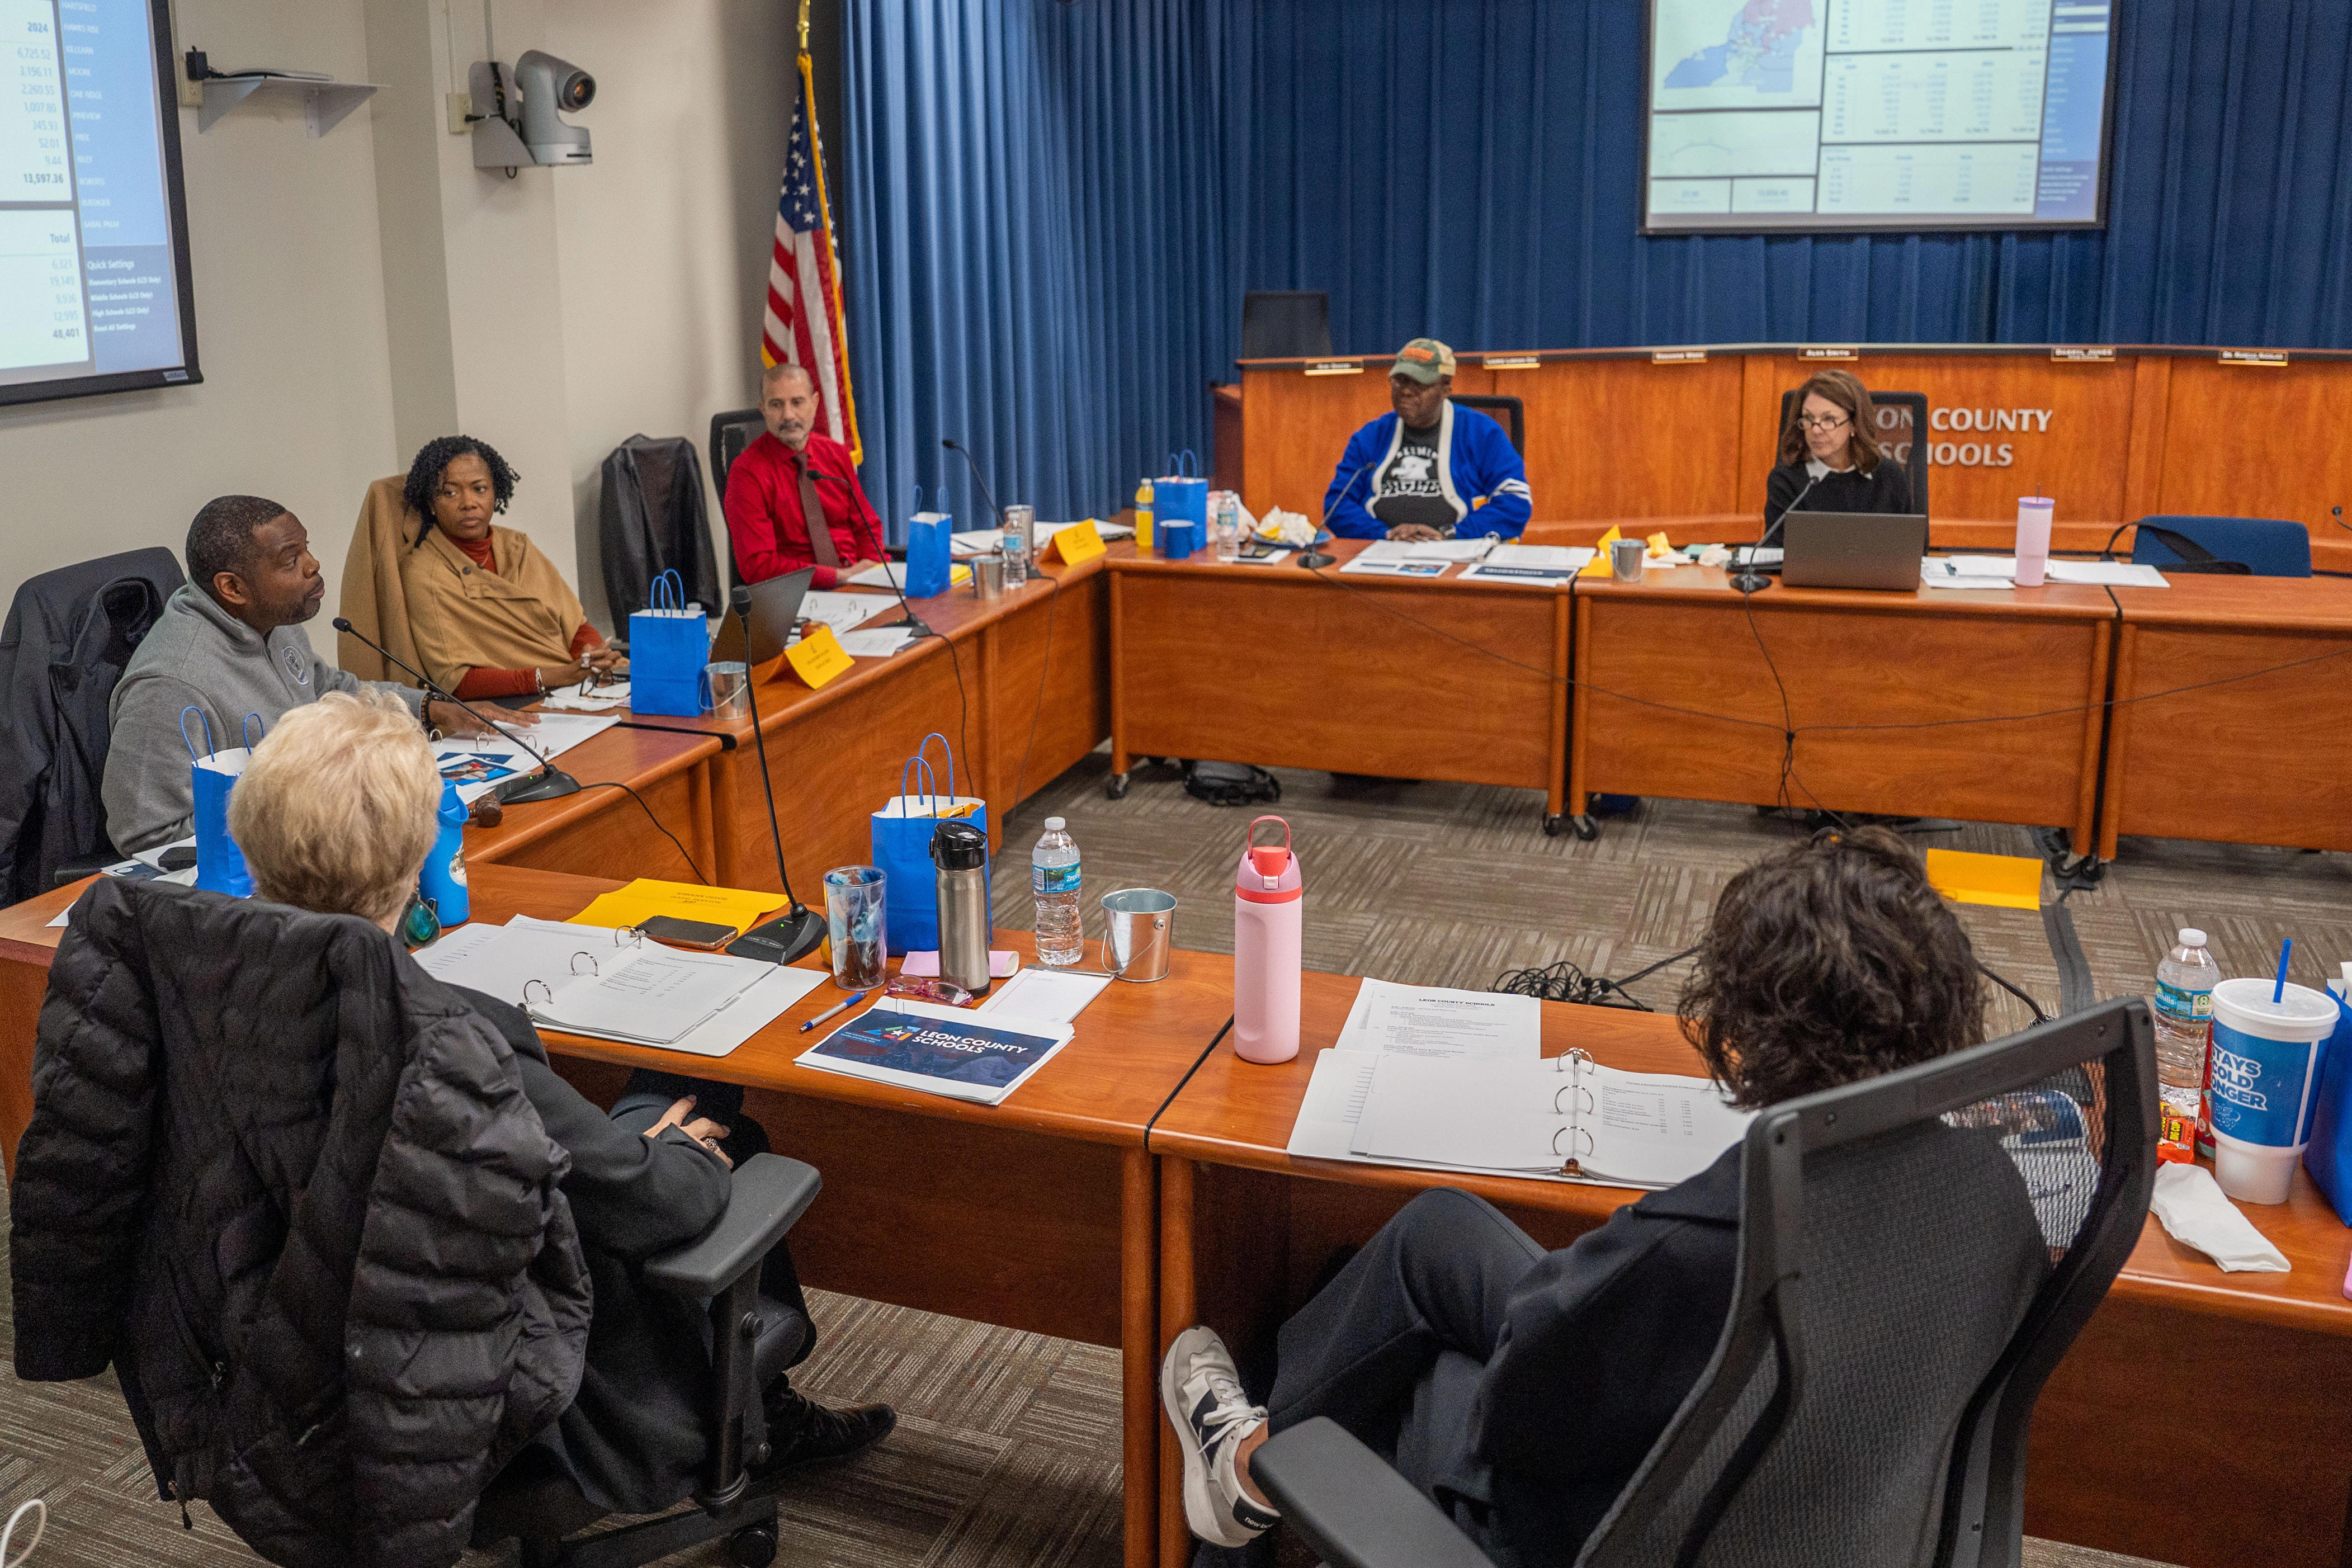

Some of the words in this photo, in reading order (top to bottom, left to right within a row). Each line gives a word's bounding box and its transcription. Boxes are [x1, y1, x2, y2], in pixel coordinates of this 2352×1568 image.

[27, 22, 48, 32] 2024
[20, 65, 53, 77] 3,196.11
[22, 84, 55, 95] 2,260.55
[23, 173, 64, 186] 13,597.36
[50, 233, 70, 243] Total
[87, 261, 107, 271] Quick
[108, 259, 134, 270] Settings
[53, 328, 80, 340] 48,401
[1931, 407, 2053, 432] COUNTY
[911, 1036, 985, 1054] SCHOOLS
[920, 1030, 961, 1042] LEON
[961, 1037, 1028, 1054] COUNTY
[2212, 1060, 2252, 1089] COLD
[2212, 1076, 2263, 1108] ONGER
[1245, 1517, 1259, 1527] new
